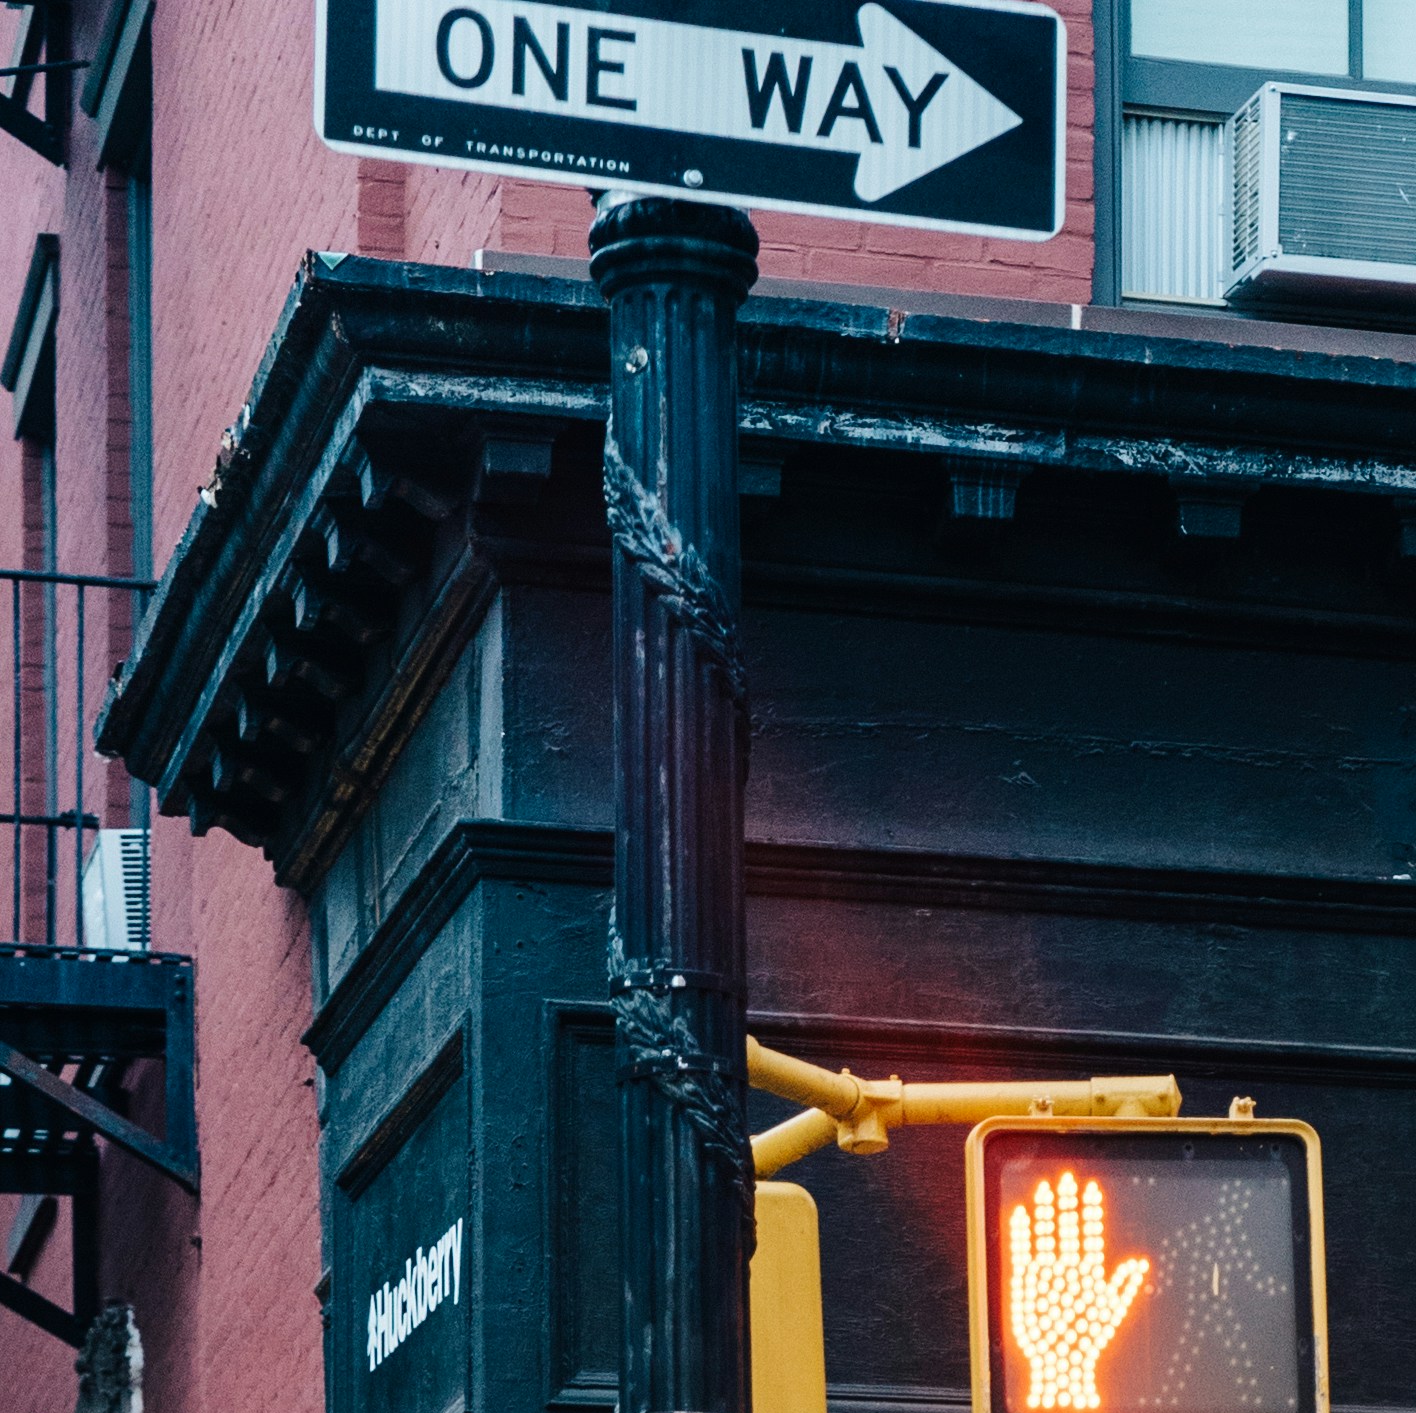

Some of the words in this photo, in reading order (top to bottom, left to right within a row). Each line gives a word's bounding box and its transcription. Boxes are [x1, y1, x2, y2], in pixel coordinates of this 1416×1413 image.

[353, 125, 399, 142] DEPT
[422, 135, 444, 148] OF
[466, 140, 630, 173] TRANSPORTATION
[436, 8, 637, 112] ONE
[742, 47, 950, 149] WAY
[376, 1217, 463, 1366] Huckberry
